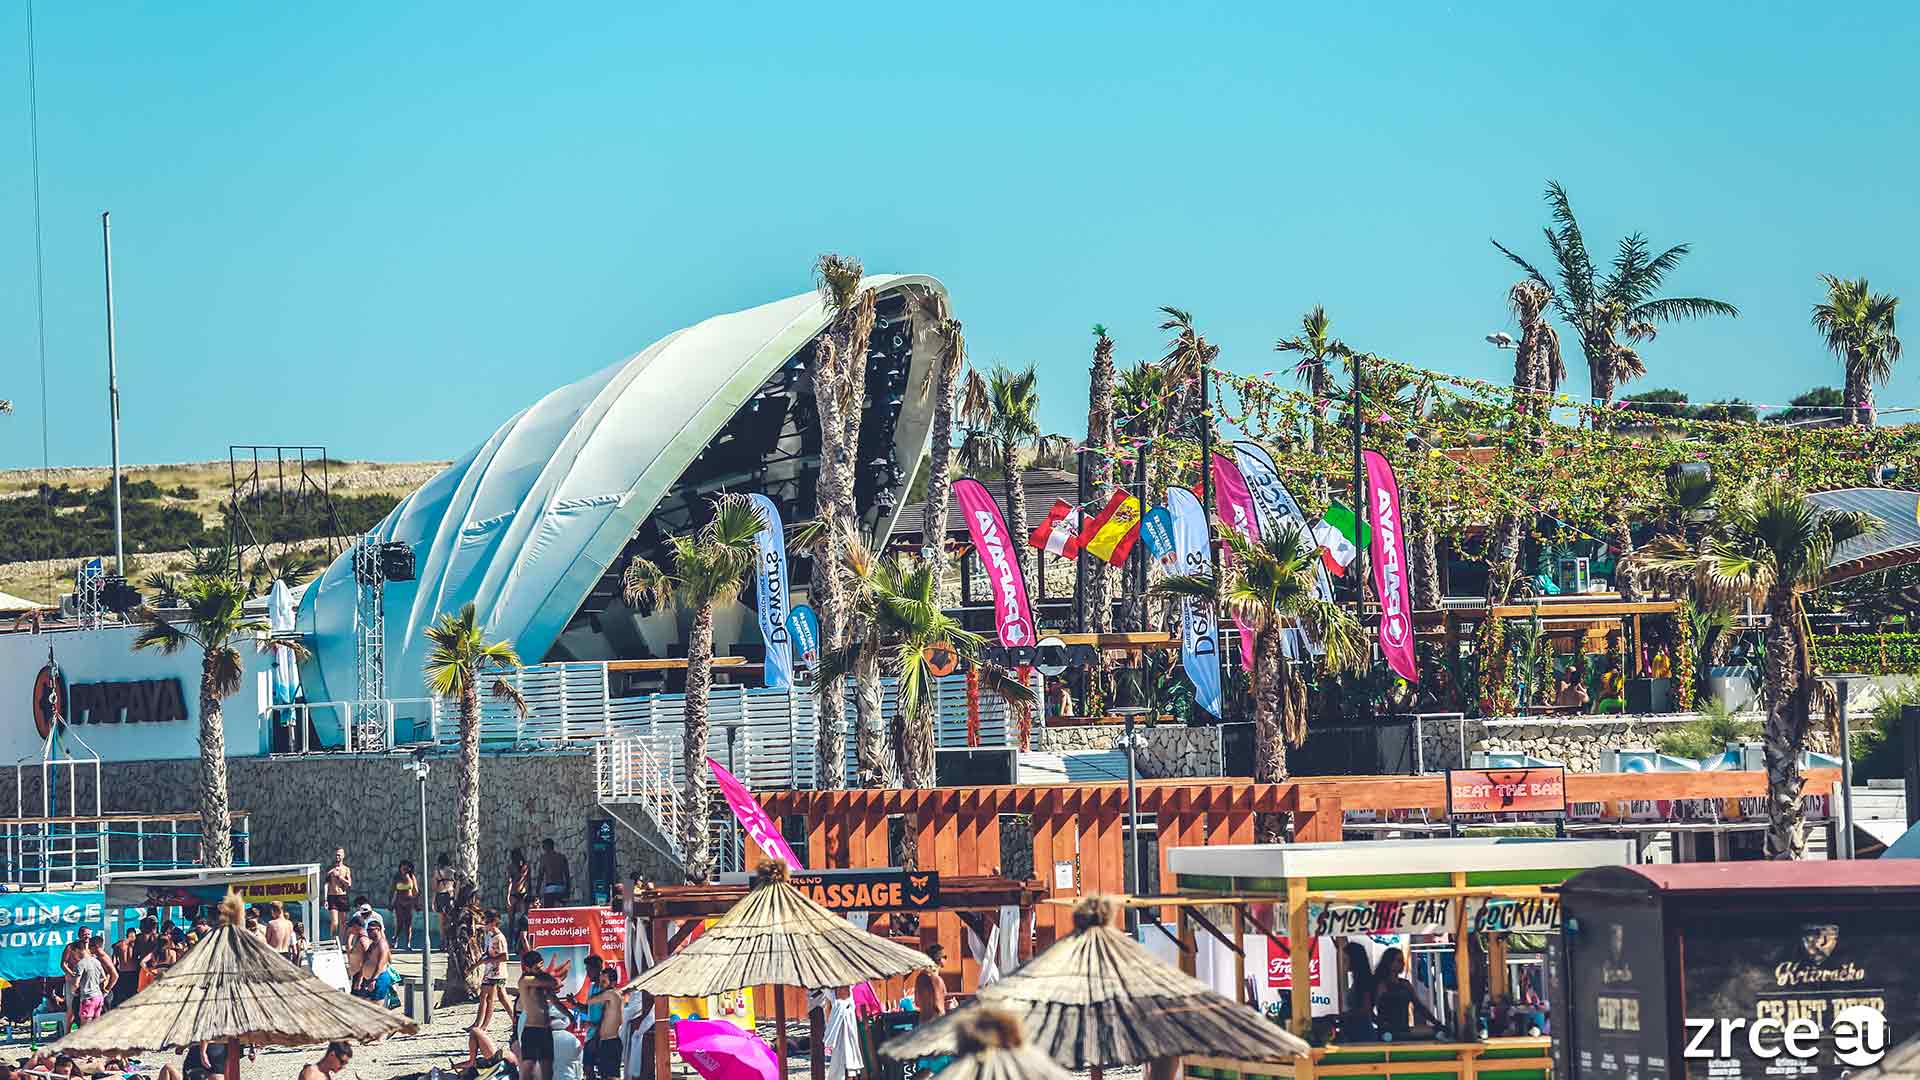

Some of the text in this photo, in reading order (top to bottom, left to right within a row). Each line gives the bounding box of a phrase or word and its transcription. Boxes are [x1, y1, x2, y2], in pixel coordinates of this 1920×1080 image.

[69, 679, 188, 725] PAPAYA
[1453, 783, 1563, 798] BEAT THE BAR
[1411, 898, 1447, 926] BAR
[1269, 958, 1319, 975] Frak
